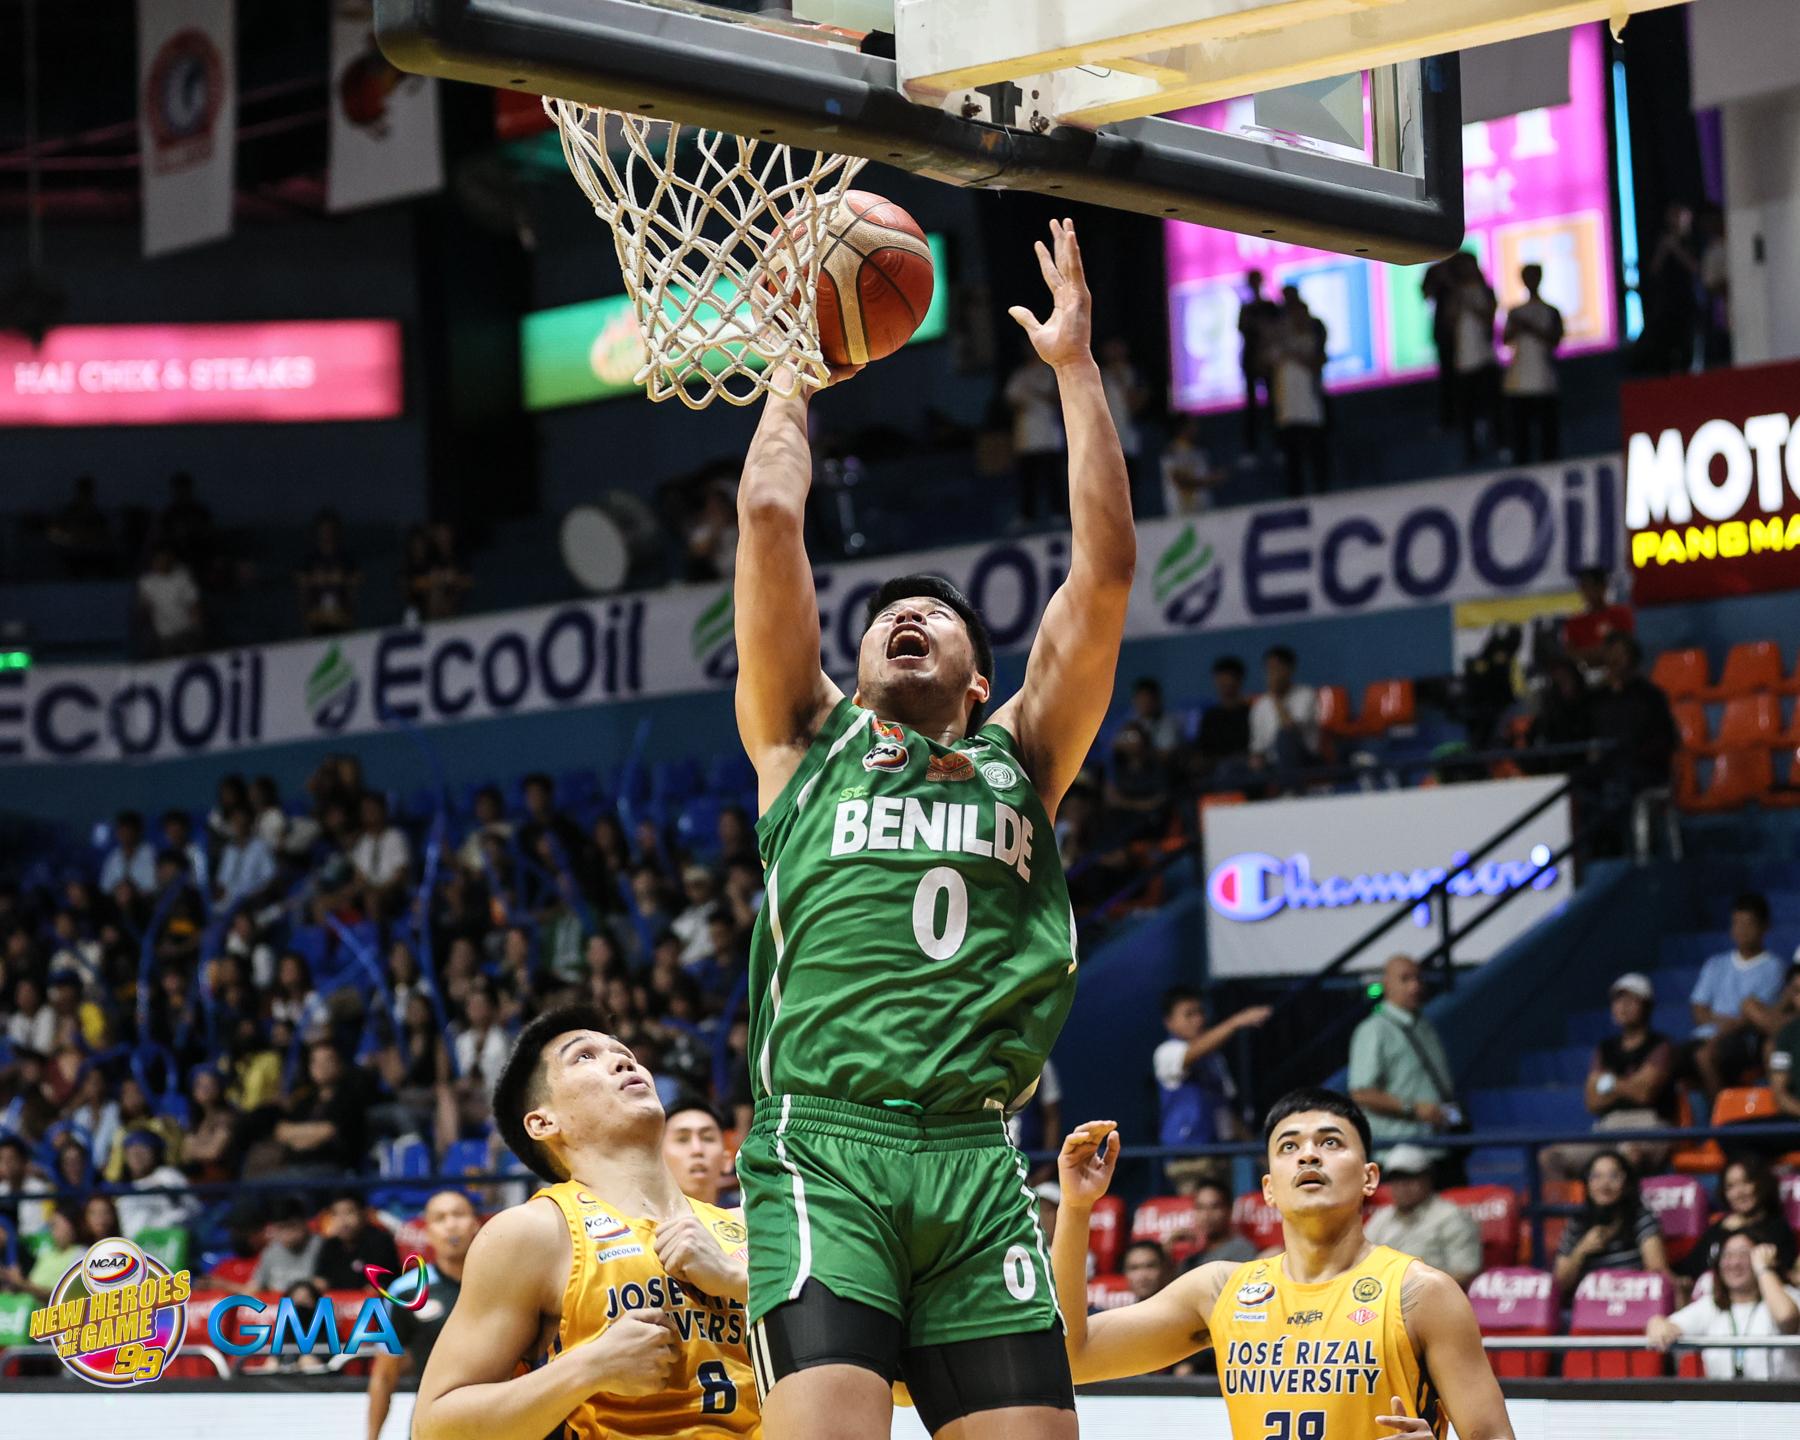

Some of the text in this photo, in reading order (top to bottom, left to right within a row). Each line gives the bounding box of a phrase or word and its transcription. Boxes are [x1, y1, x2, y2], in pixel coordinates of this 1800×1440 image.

[189, 355, 316, 391] STEAKS
[1626, 412, 1800, 530] MOT
[1243, 464, 1616, 617] EcoOil
[374, 601, 645, 721] EcoOil
[830, 795, 1034, 884] BENILDE
[912, 866, 969, 961] 0
[1003, 1245, 1036, 1300] 0
[1225, 1368, 1381, 1395] UNIVERSITY
[1226, 1335, 1377, 1366] JOSÉ RIZAL
[697, 1359, 738, 1416] 8
